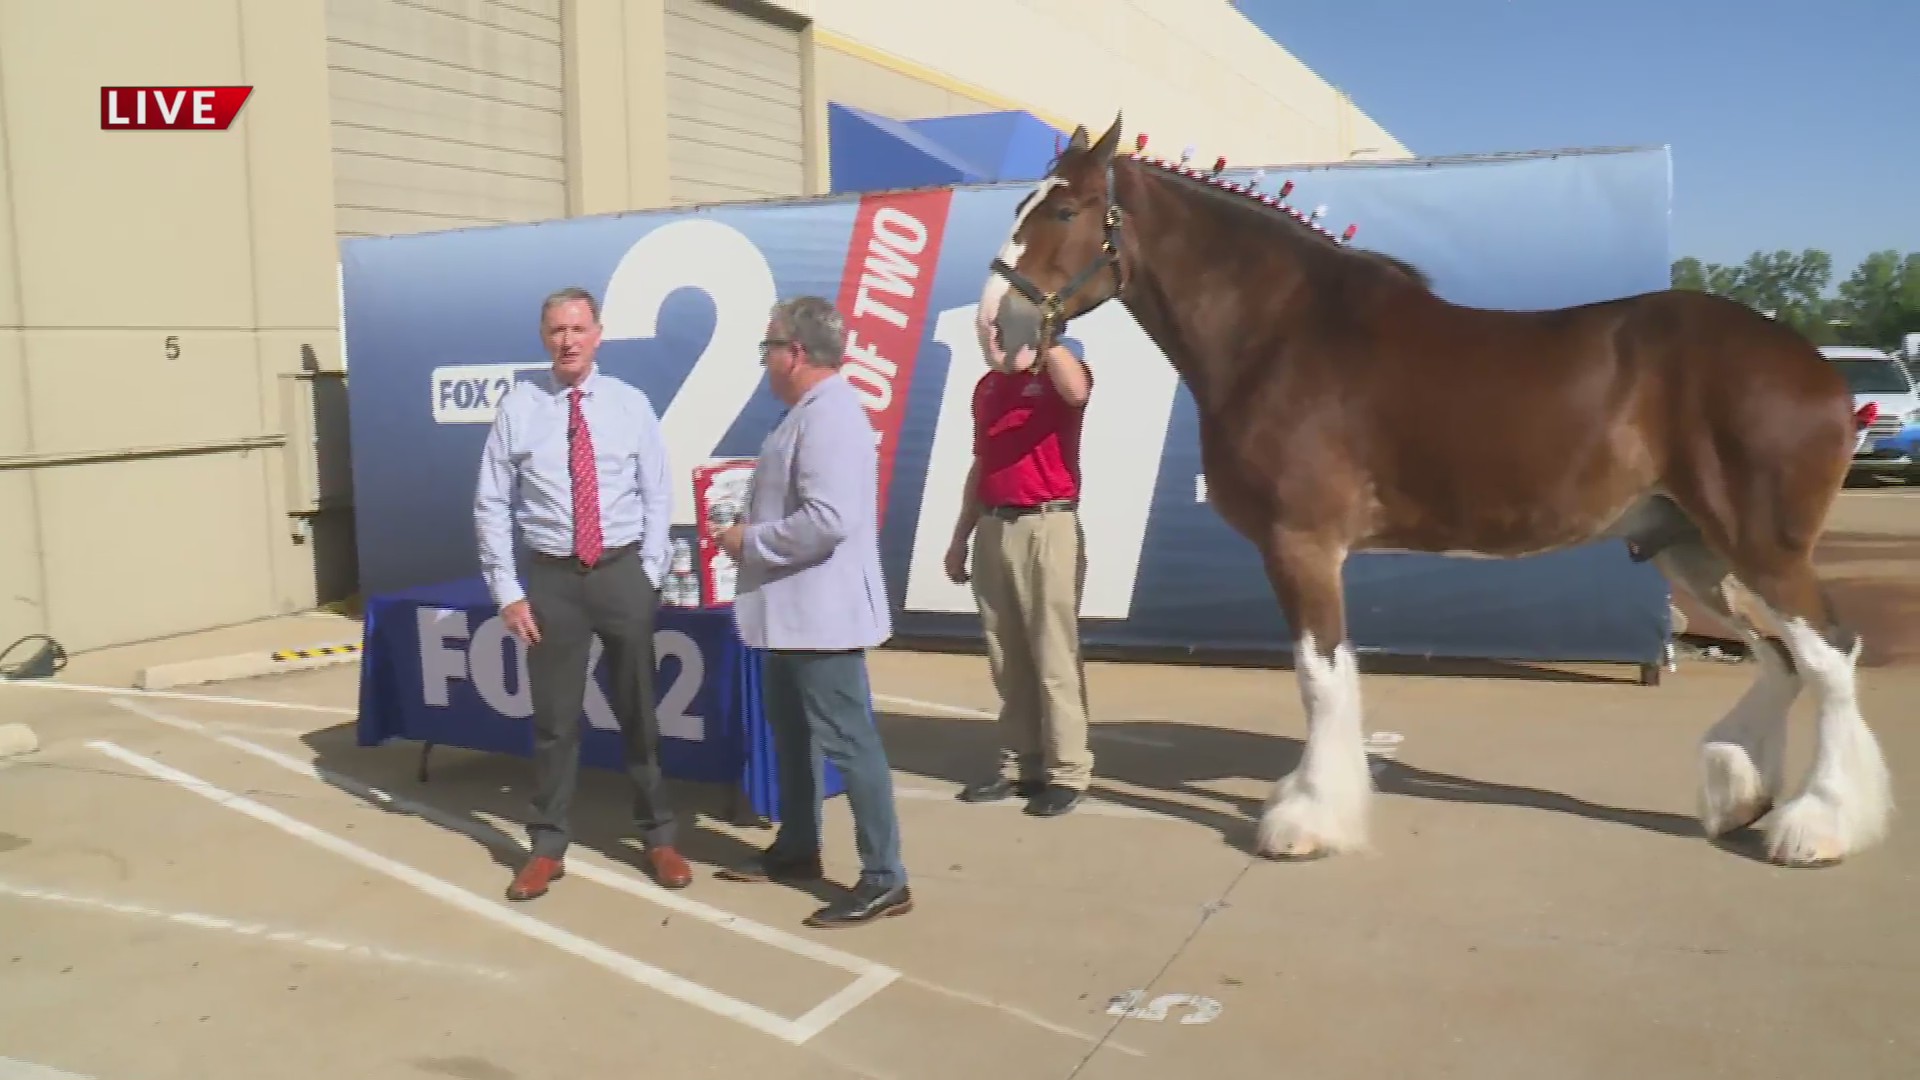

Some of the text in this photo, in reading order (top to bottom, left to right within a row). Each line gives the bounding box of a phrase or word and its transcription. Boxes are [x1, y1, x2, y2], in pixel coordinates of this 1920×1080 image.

[165, 335, 181, 361] 5
[840, 207, 928, 412] OF TWO
[440, 379, 490, 410] FOX
[601, 219, 777, 526] 2
[652, 629, 706, 743] 2
